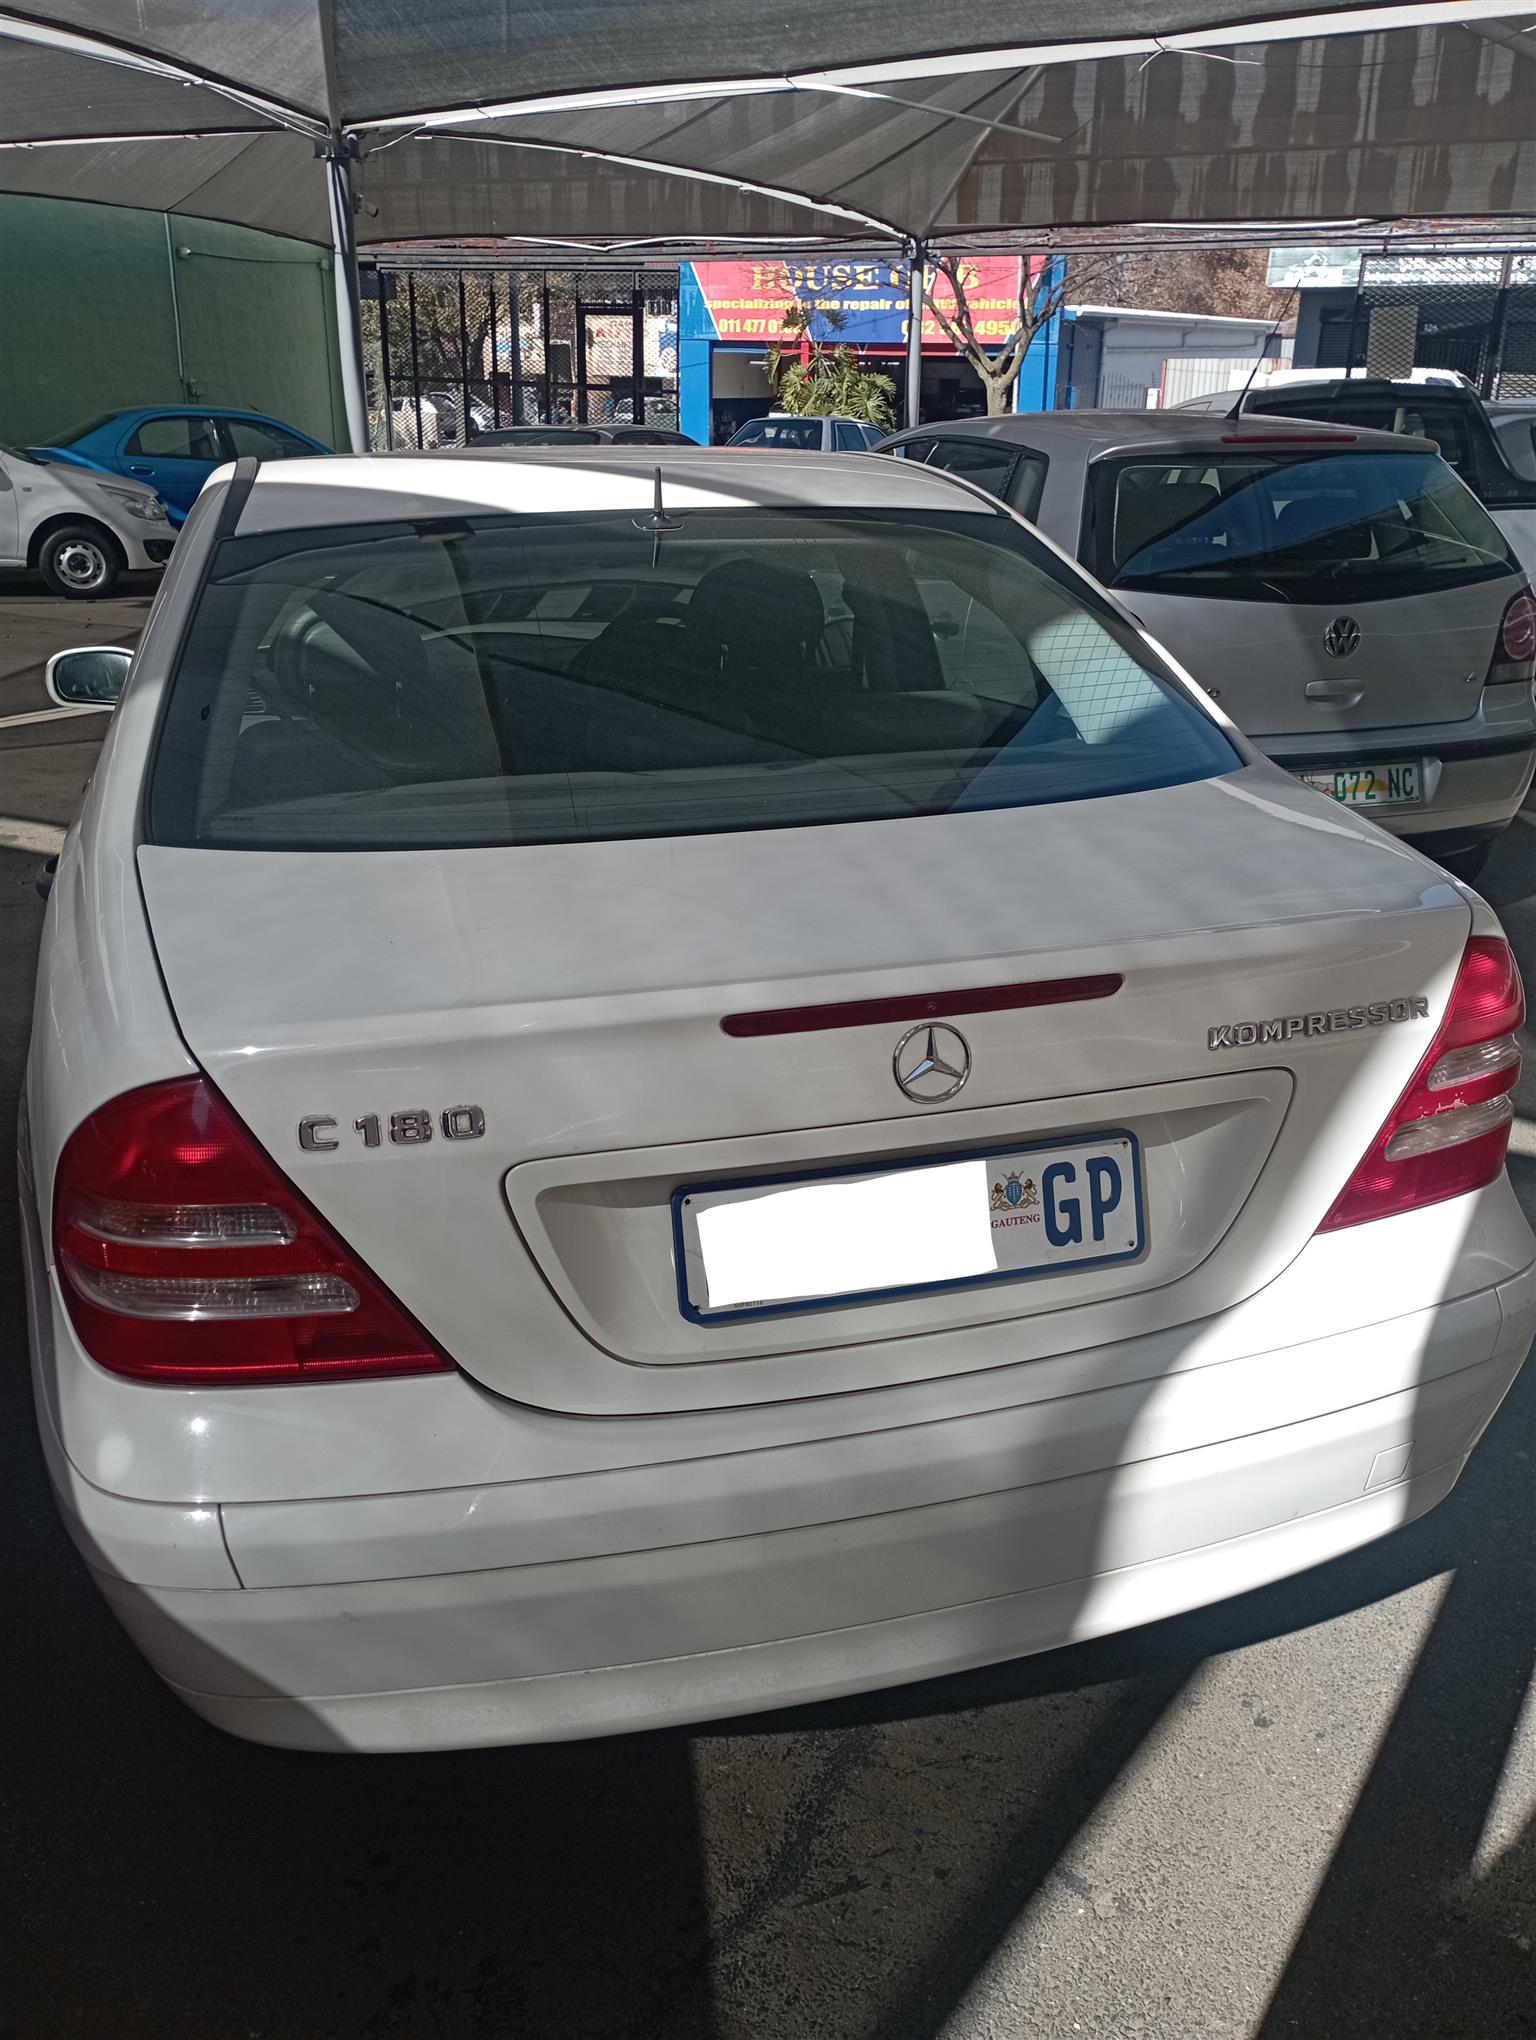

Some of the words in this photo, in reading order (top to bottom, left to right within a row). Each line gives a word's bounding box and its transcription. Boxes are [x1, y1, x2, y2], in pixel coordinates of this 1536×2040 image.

[751, 265, 879, 292] HOUSE
[815, 299, 840, 310] the
[844, 299, 892, 312] repair
[895, 299, 909, 310] of
[718, 318, 741, 333] 011
[743, 318, 767, 333] 477
[1334, 770, 1377, 802] 072
[1388, 767, 1414, 798] NC
[1208, 995, 1429, 1050] KOMPRESSOR
[298, 1114, 340, 1151] C
[353, 1104, 486, 1148] 180
[1041, 1155, 1123, 1248] GP
[991, 1213, 1041, 1230] GAUTENG
